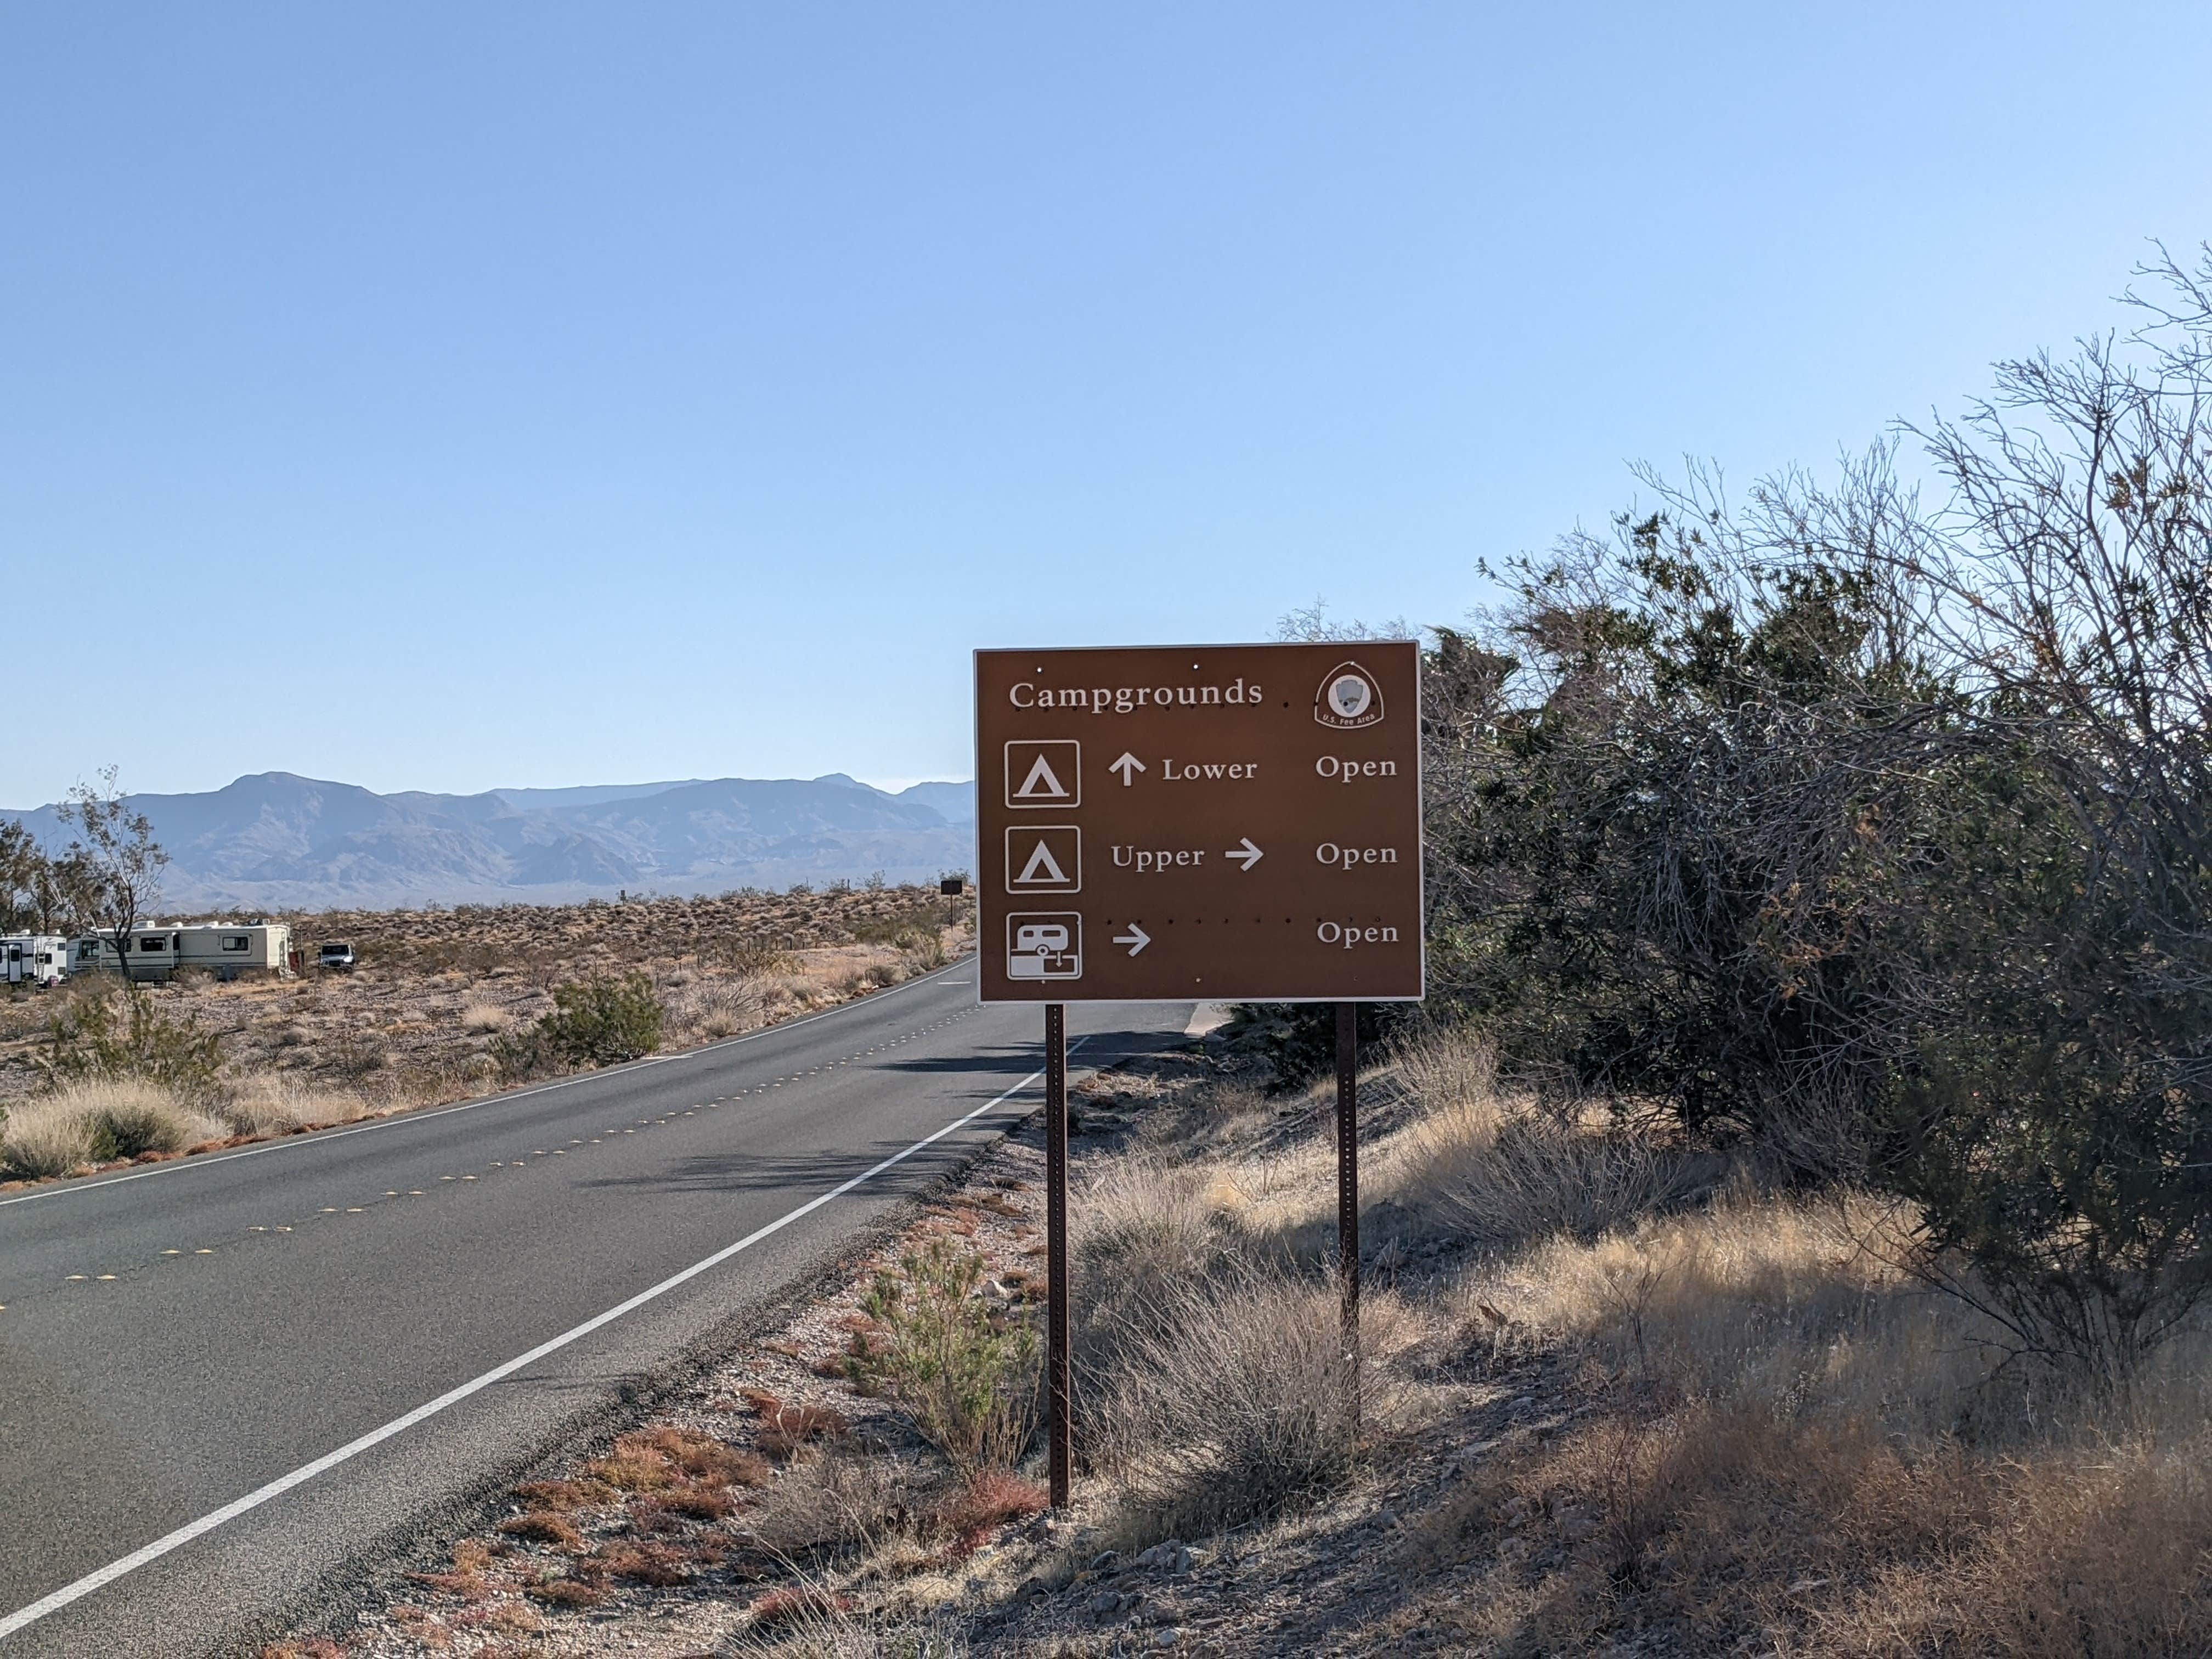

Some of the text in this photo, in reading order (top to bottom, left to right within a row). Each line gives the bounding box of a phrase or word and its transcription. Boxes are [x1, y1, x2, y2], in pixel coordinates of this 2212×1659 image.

[1009, 678, 1262, 714] Campgrounds
[1323, 714, 1336, 724] U.S.
[1357, 714, 1375, 724] Area
[1162, 759, 1257, 780] Lower
[1316, 756, 1397, 783] Open
[1111, 845, 1205, 872] Upper
[1316, 843, 1397, 870] Open
[1317, 922, 1399, 949] Open
